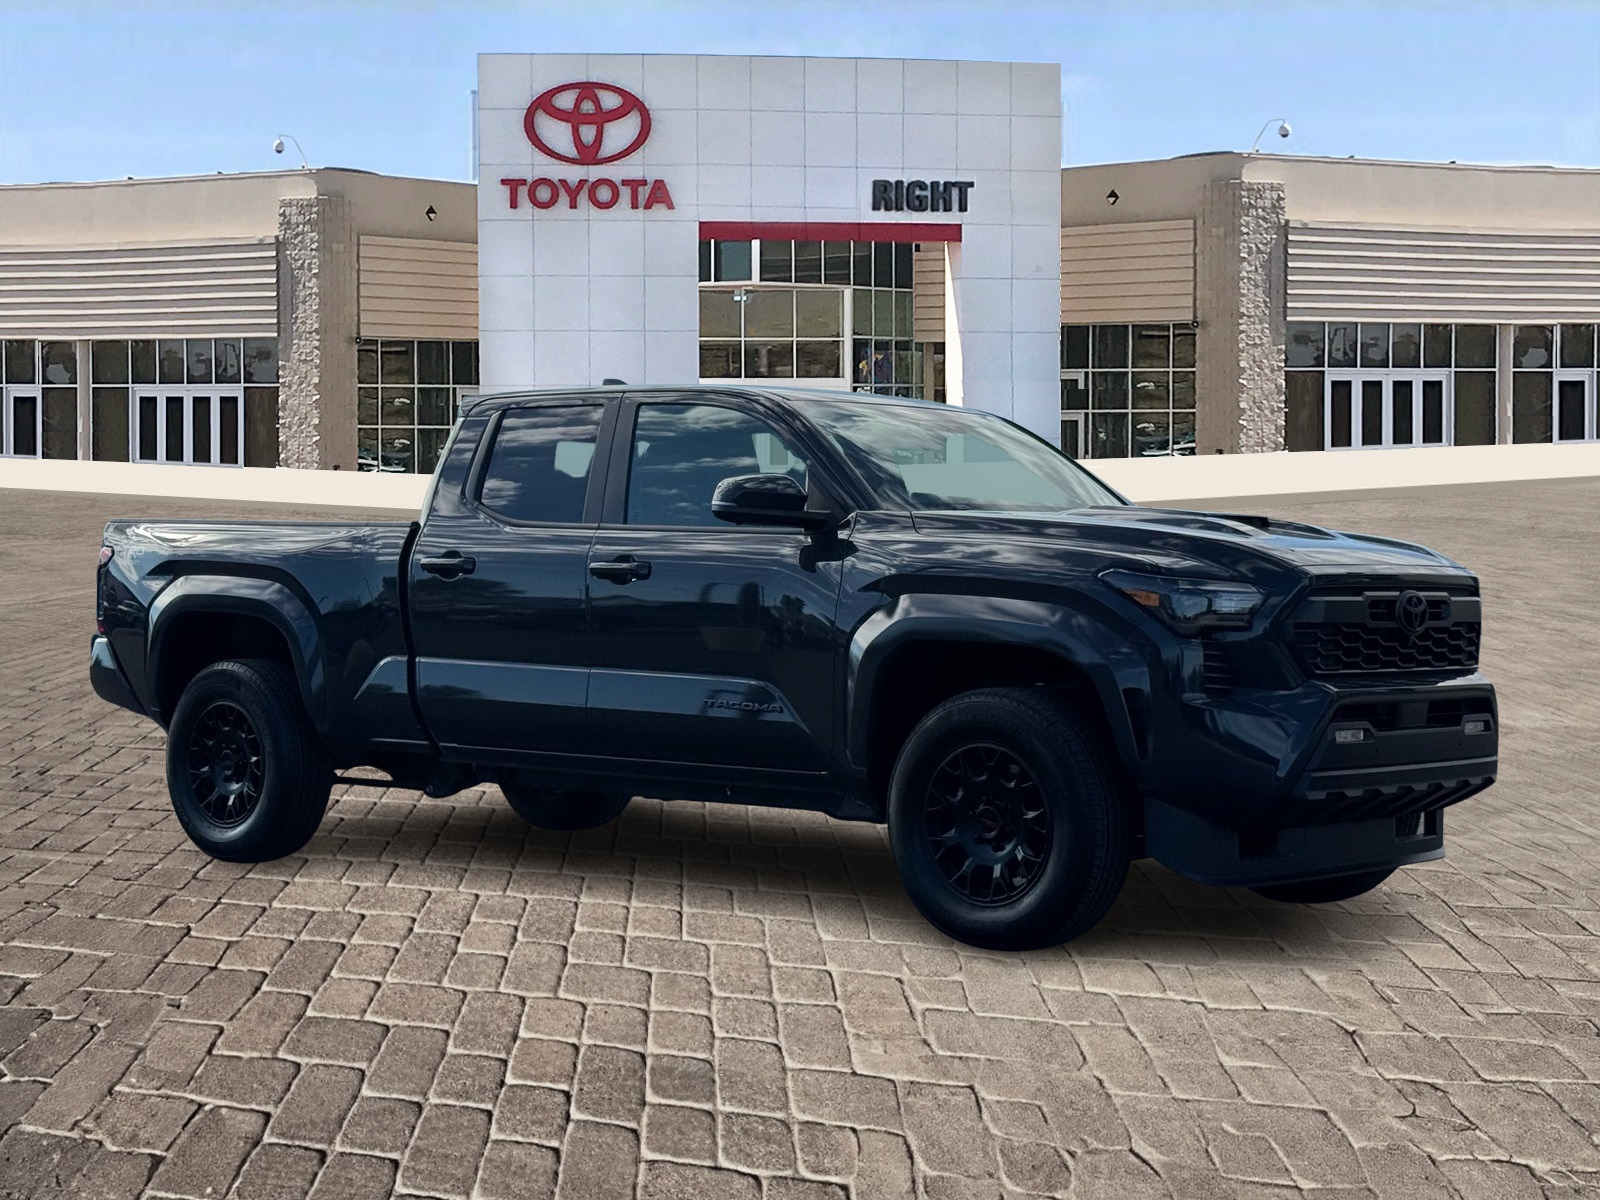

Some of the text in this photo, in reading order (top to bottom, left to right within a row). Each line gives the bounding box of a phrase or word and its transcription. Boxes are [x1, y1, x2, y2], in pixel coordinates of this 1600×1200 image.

[500, 177, 675, 210] TOYOTA
[872, 179, 975, 212] RIGHT
[703, 699, 784, 713] TACOMA
